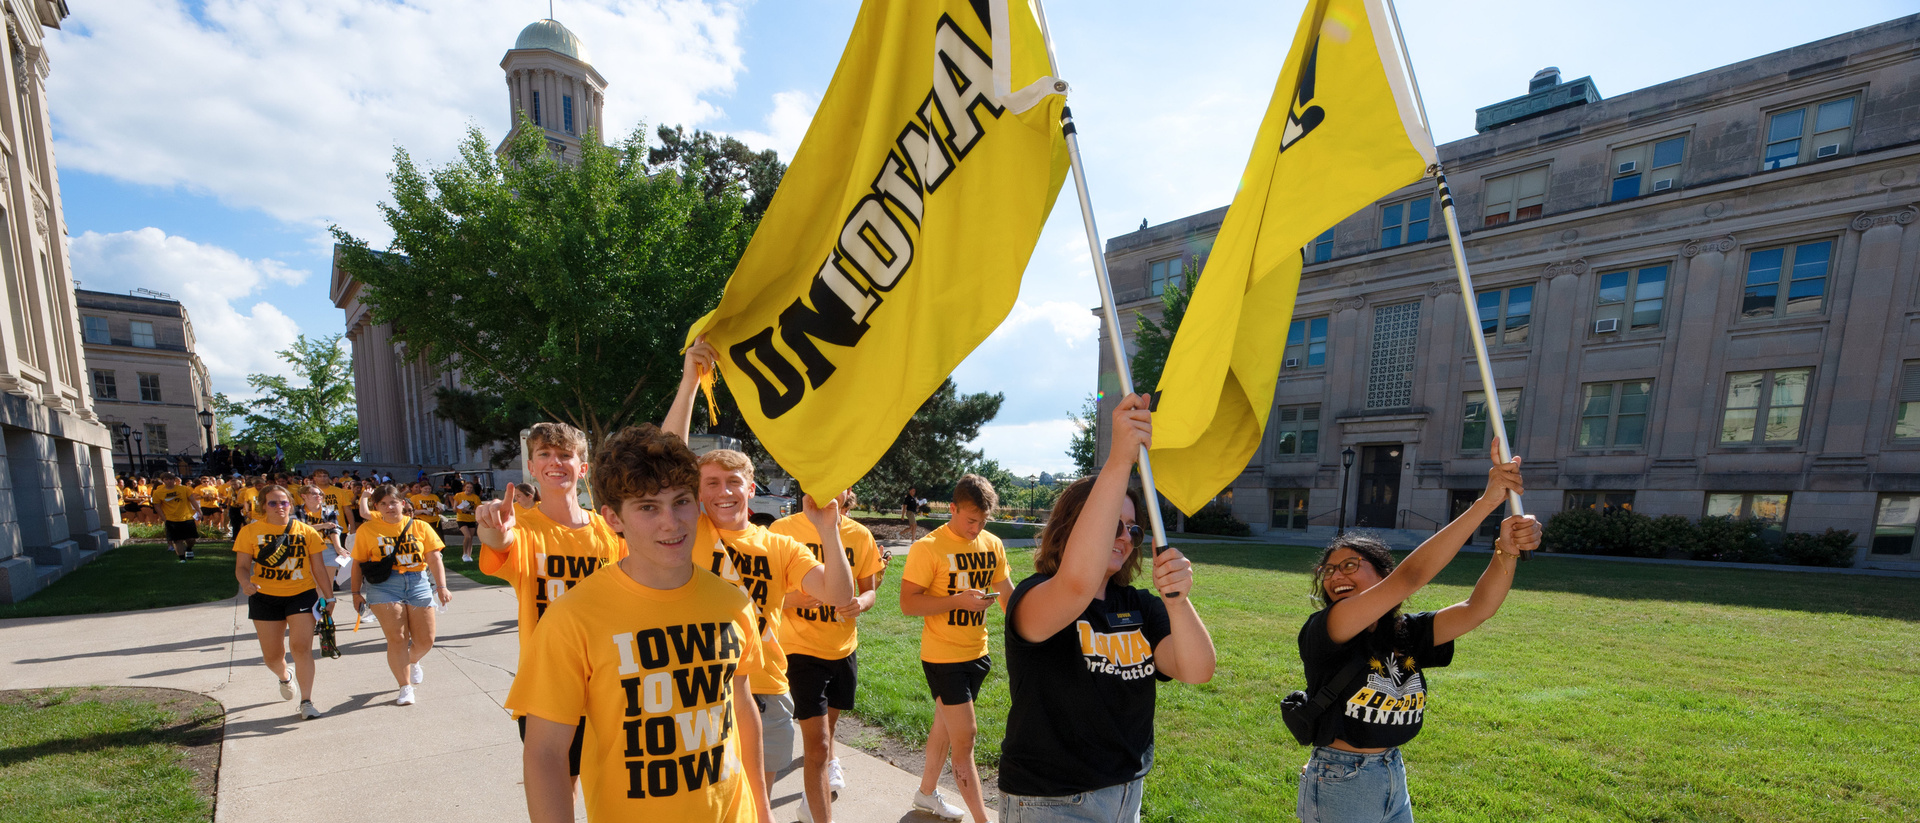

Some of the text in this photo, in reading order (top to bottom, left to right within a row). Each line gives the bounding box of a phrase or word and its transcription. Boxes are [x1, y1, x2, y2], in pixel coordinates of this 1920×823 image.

[259, 567, 304, 580] IOWA
[265, 544, 288, 566] IOWA
[279, 558, 304, 570] WA
[947, 551, 997, 572] IOWA
[612, 622, 741, 676] IOWA
[1076, 620, 1153, 667] IOWA
[620, 663, 737, 717] IOWA
[623, 700, 733, 758] IOWA
[625, 740, 741, 799] IOWA
